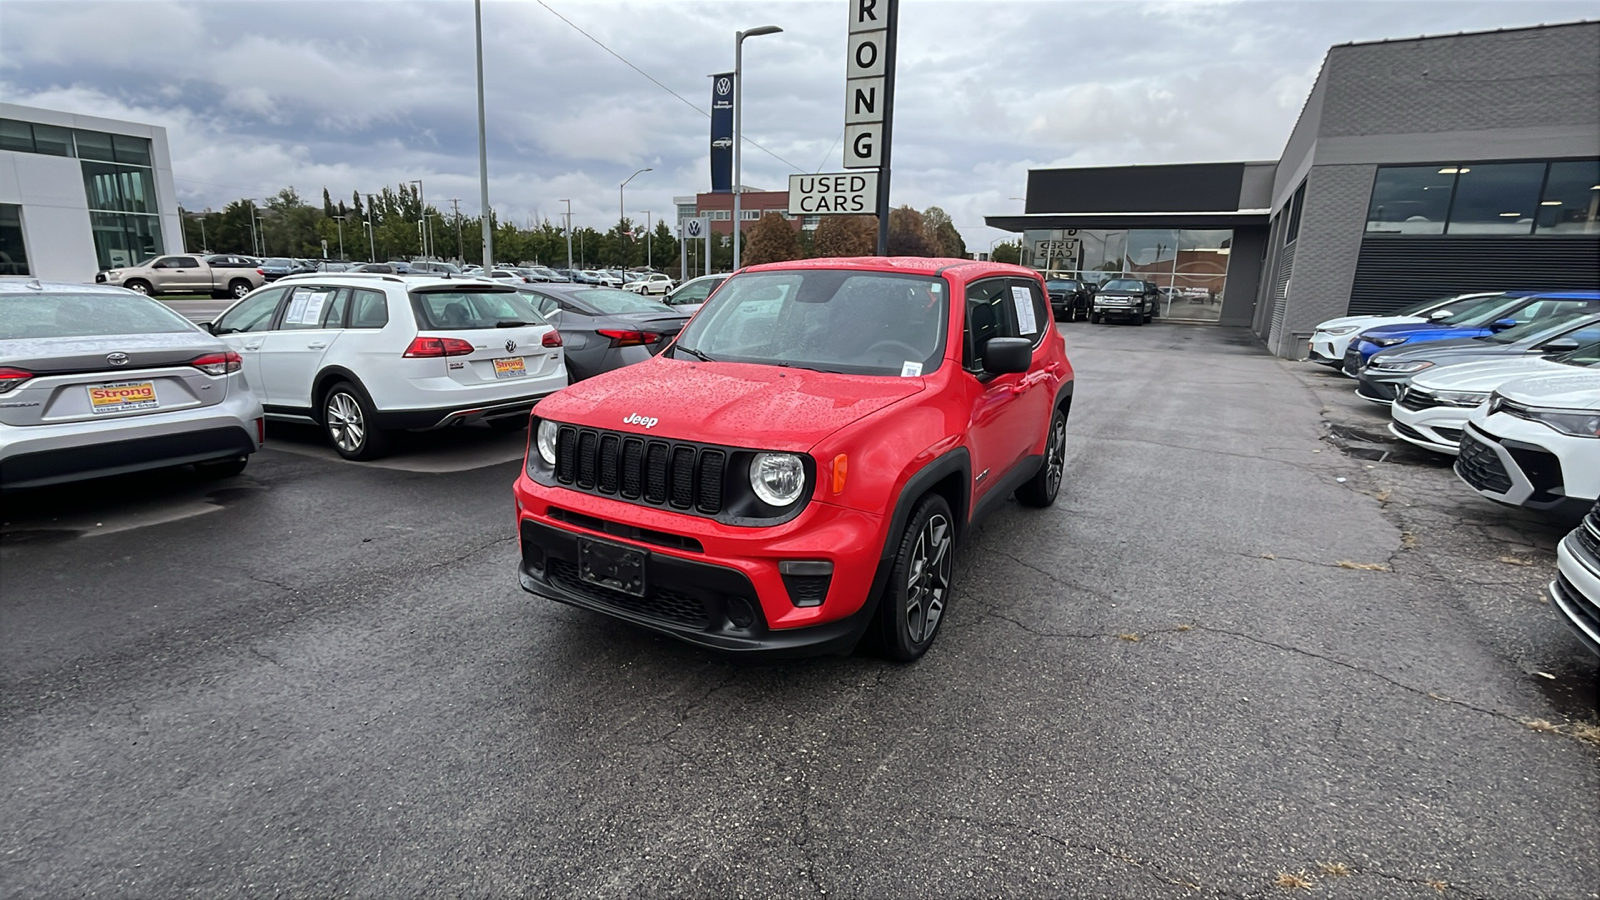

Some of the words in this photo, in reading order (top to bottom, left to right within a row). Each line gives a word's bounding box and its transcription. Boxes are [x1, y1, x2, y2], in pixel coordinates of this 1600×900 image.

[800, 176, 866, 194] USED
[800, 194, 864, 212] CARS
[496, 360, 524, 369] Strong
[93, 387, 152, 399] Strong
[623, 412, 659, 429] Jeep
